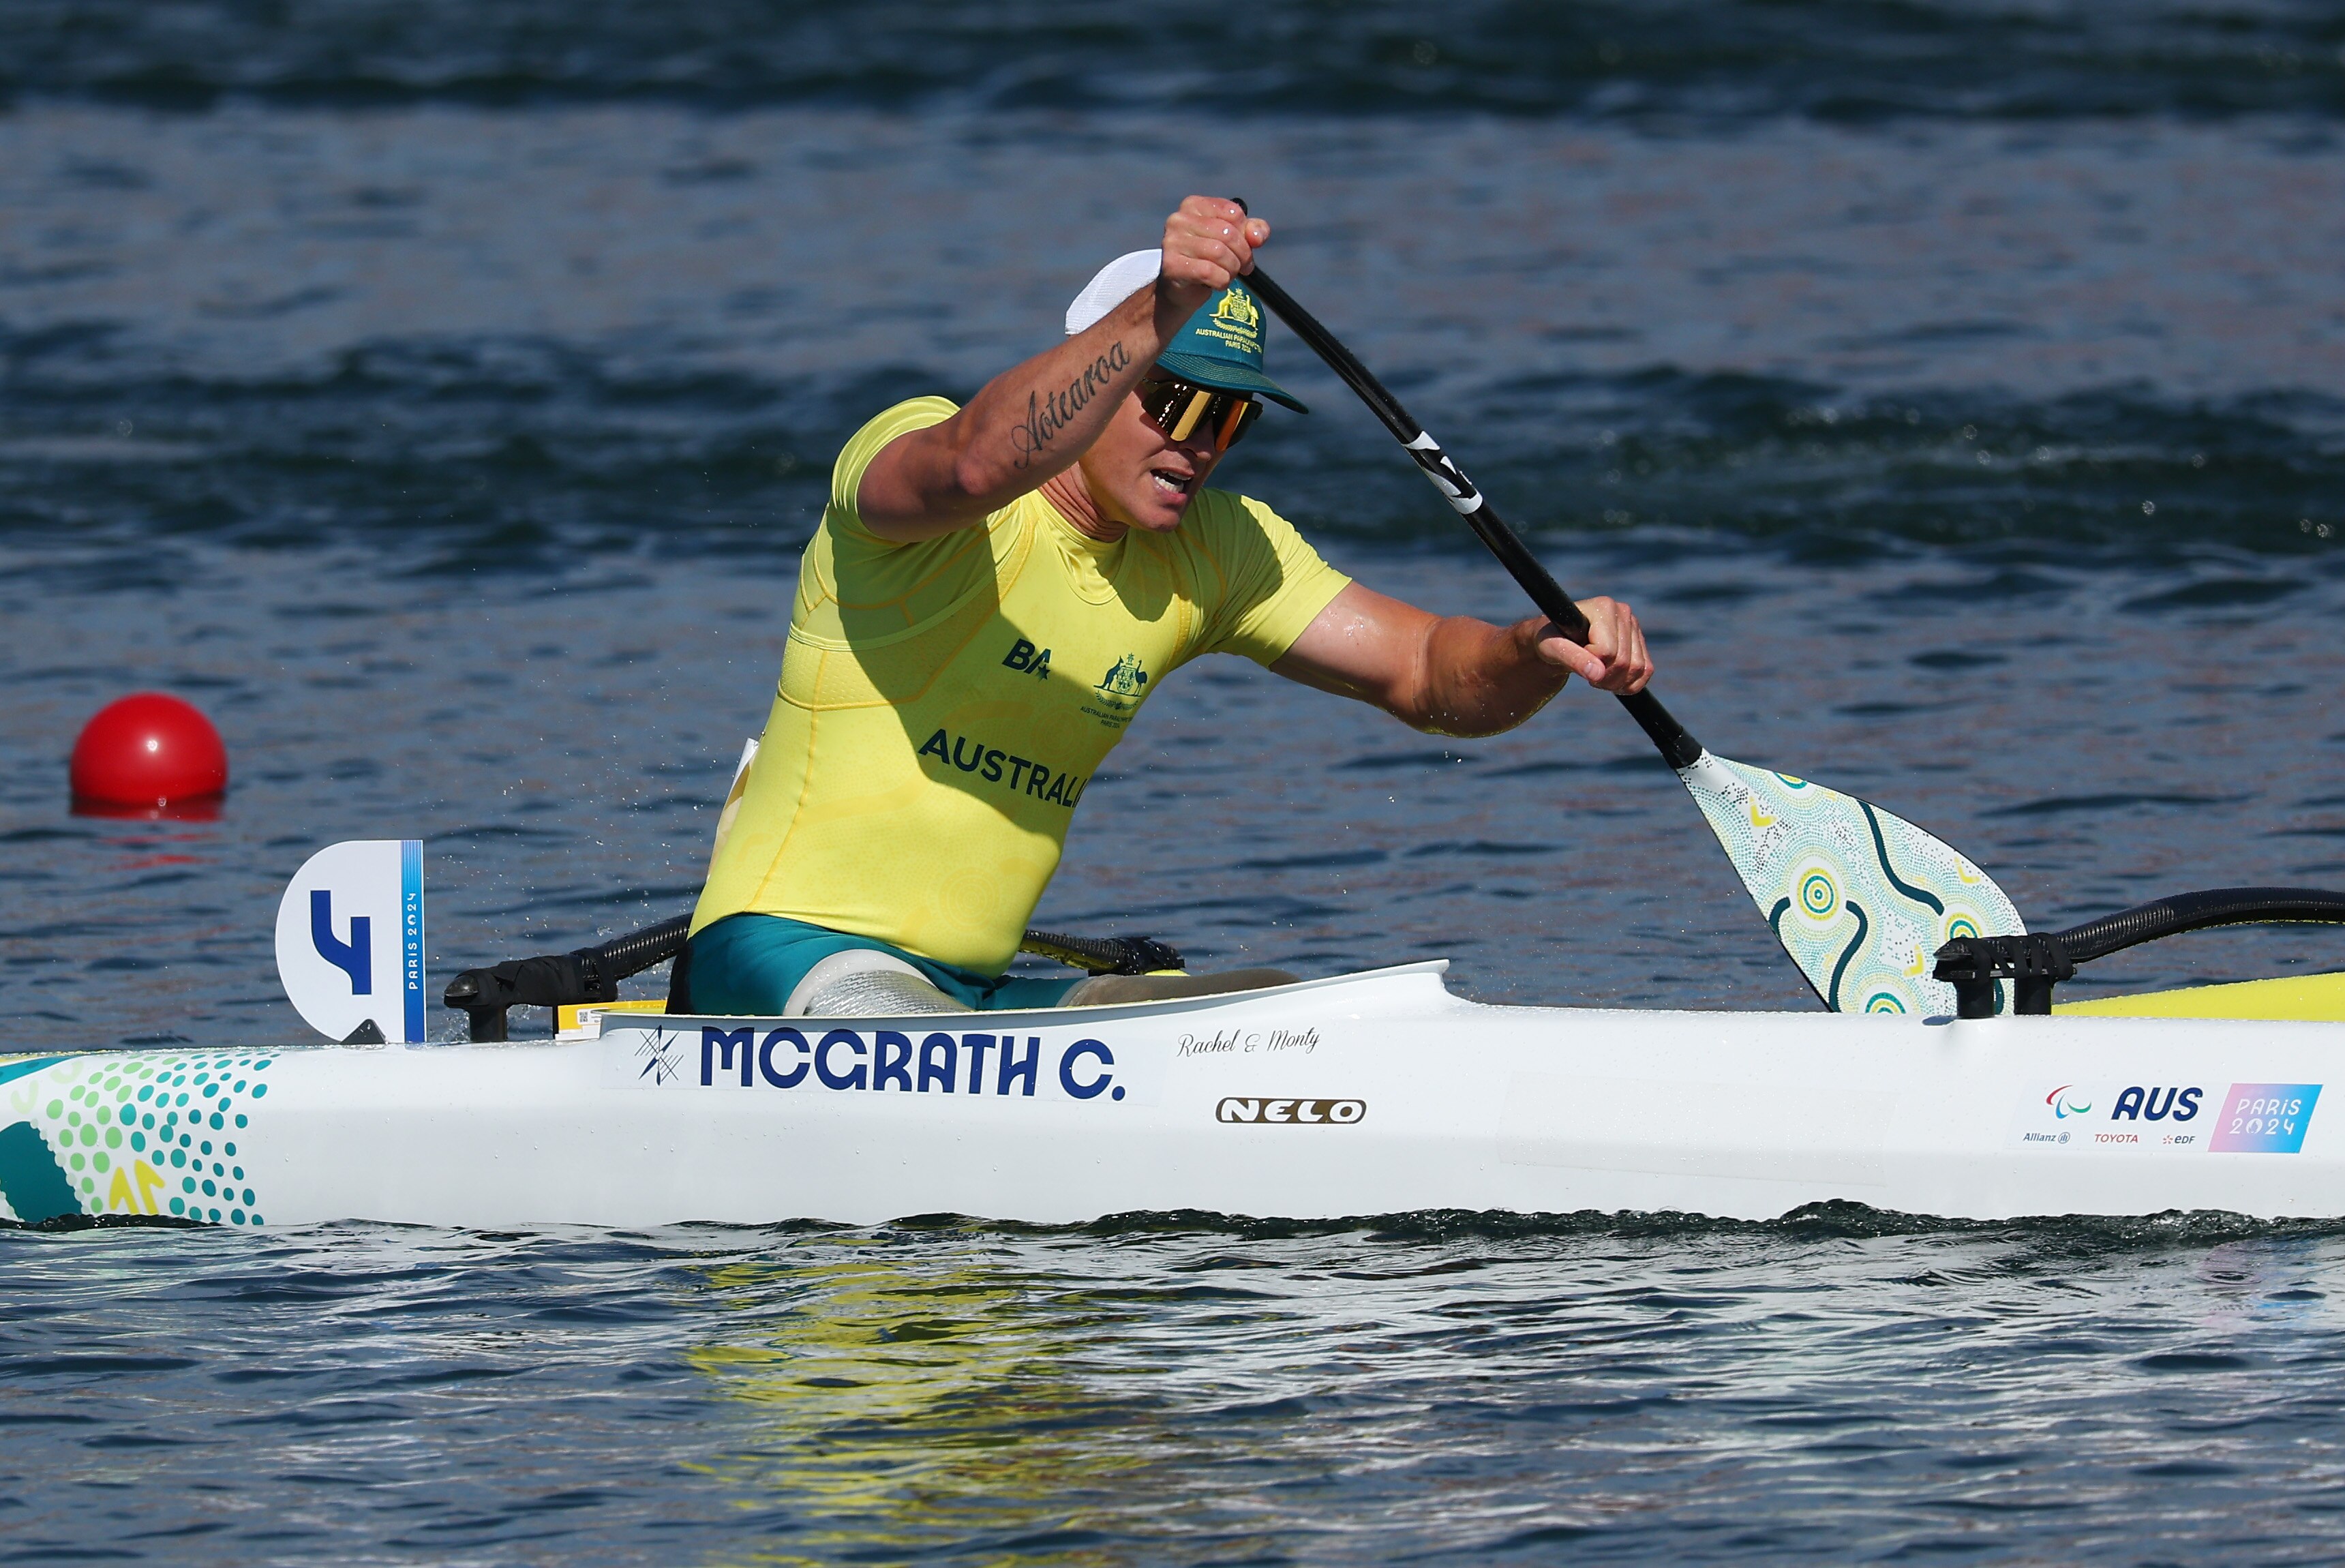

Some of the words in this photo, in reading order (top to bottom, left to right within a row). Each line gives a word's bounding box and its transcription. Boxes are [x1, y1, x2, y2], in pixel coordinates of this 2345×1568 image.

[1195, 328, 1233, 340] AUSTRALIAN
[1011, 341, 1130, 470] Aotearoa
[918, 728, 1087, 809] AUSTRALI
[407, 893, 417, 936] 2024
[310, 890, 372, 995] 4
[408, 942, 418, 990] PARIS
[1177, 1029, 1241, 1057] Rachel
[1244, 1034, 1261, 1053] &
[1267, 1027, 1320, 1055] Monty
[699, 1026, 1040, 1097] MCGRATH
[1059, 1038, 1126, 1101] C.
[1220, 1099, 1363, 1122] NELO
[2110, 1086, 2203, 1121] AUS
[2023, 1132, 2057, 1143] Allianz
[2094, 1134, 2138, 1143] TOYOTA
[2229, 1117, 2295, 1135] 2024
